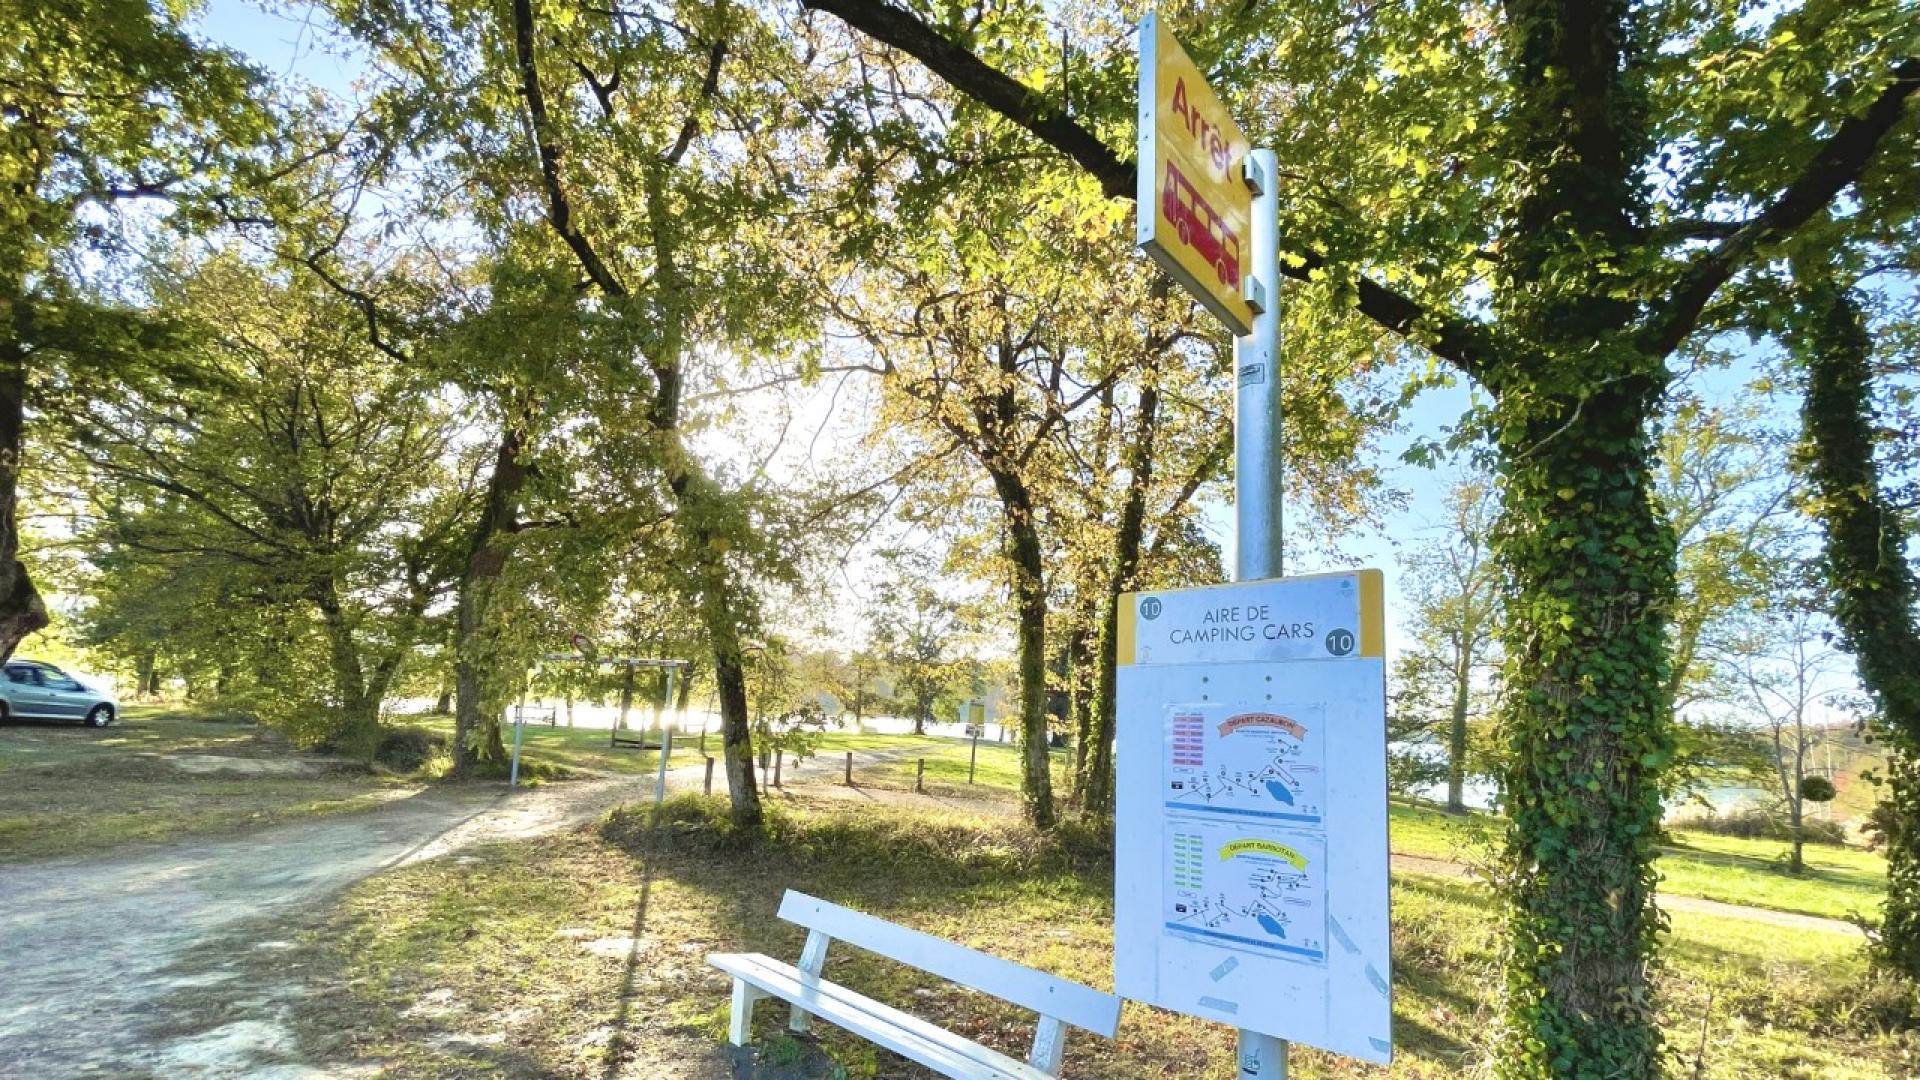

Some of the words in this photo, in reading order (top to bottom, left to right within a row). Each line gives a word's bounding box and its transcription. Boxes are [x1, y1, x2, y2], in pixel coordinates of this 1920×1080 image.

[1172, 76, 1232, 184] Arrêt
[1142, 602, 1160, 617] 10
[1203, 607, 1240, 624] AIRE
[1247, 605, 1269, 620] DE
[1170, 626, 1255, 644] CAMPING
[1263, 622, 1314, 640] CARS
[1328, 635, 1351, 650] 10
